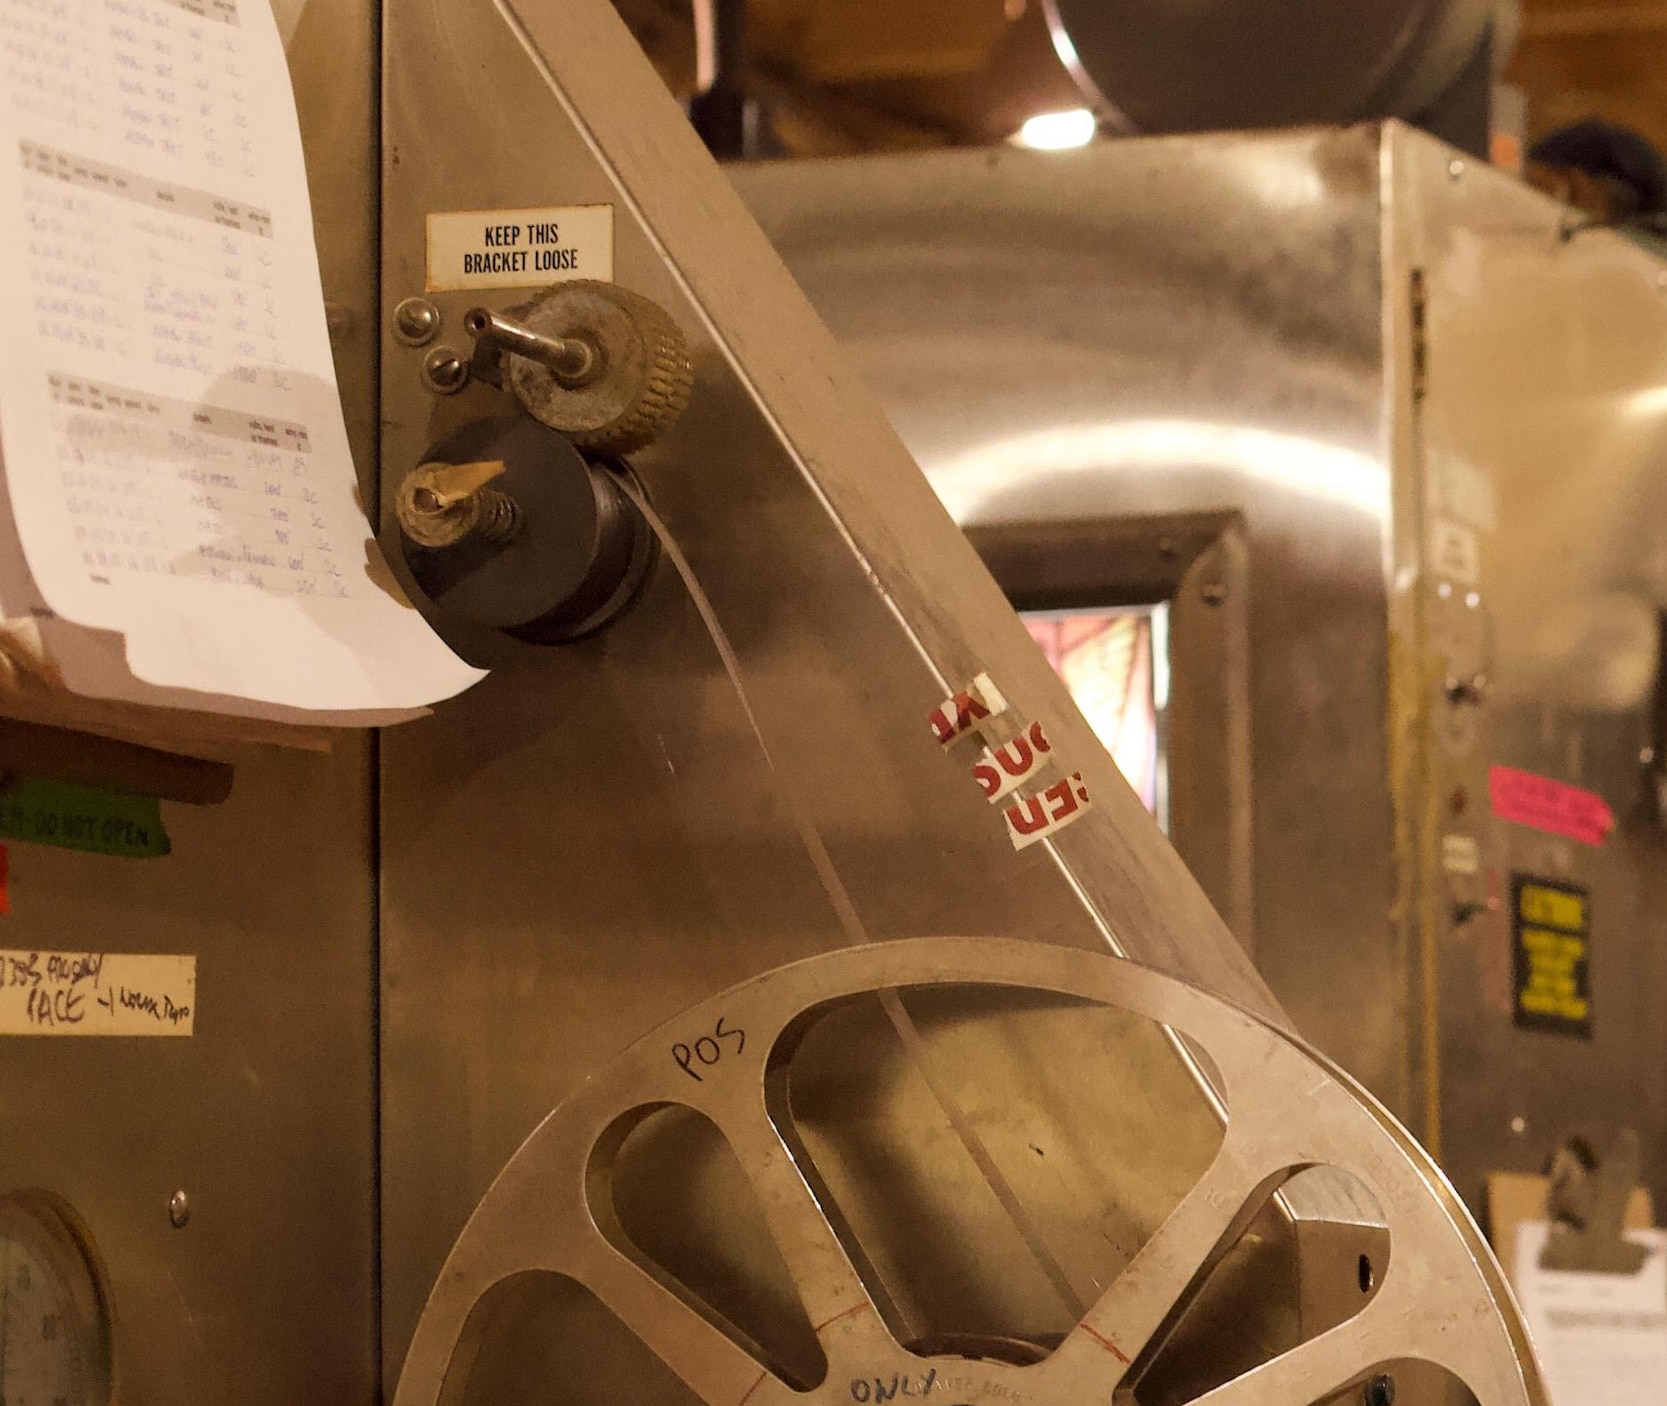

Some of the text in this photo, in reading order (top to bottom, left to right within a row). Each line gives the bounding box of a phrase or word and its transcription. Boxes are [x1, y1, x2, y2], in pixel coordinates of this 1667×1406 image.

[485, 223, 559, 247] KEEP THIS
[464, 249, 578, 274] BRACKET LOOSE
[672, 1017, 745, 1082] POS
[850, 1367, 937, 1404] ONLY
